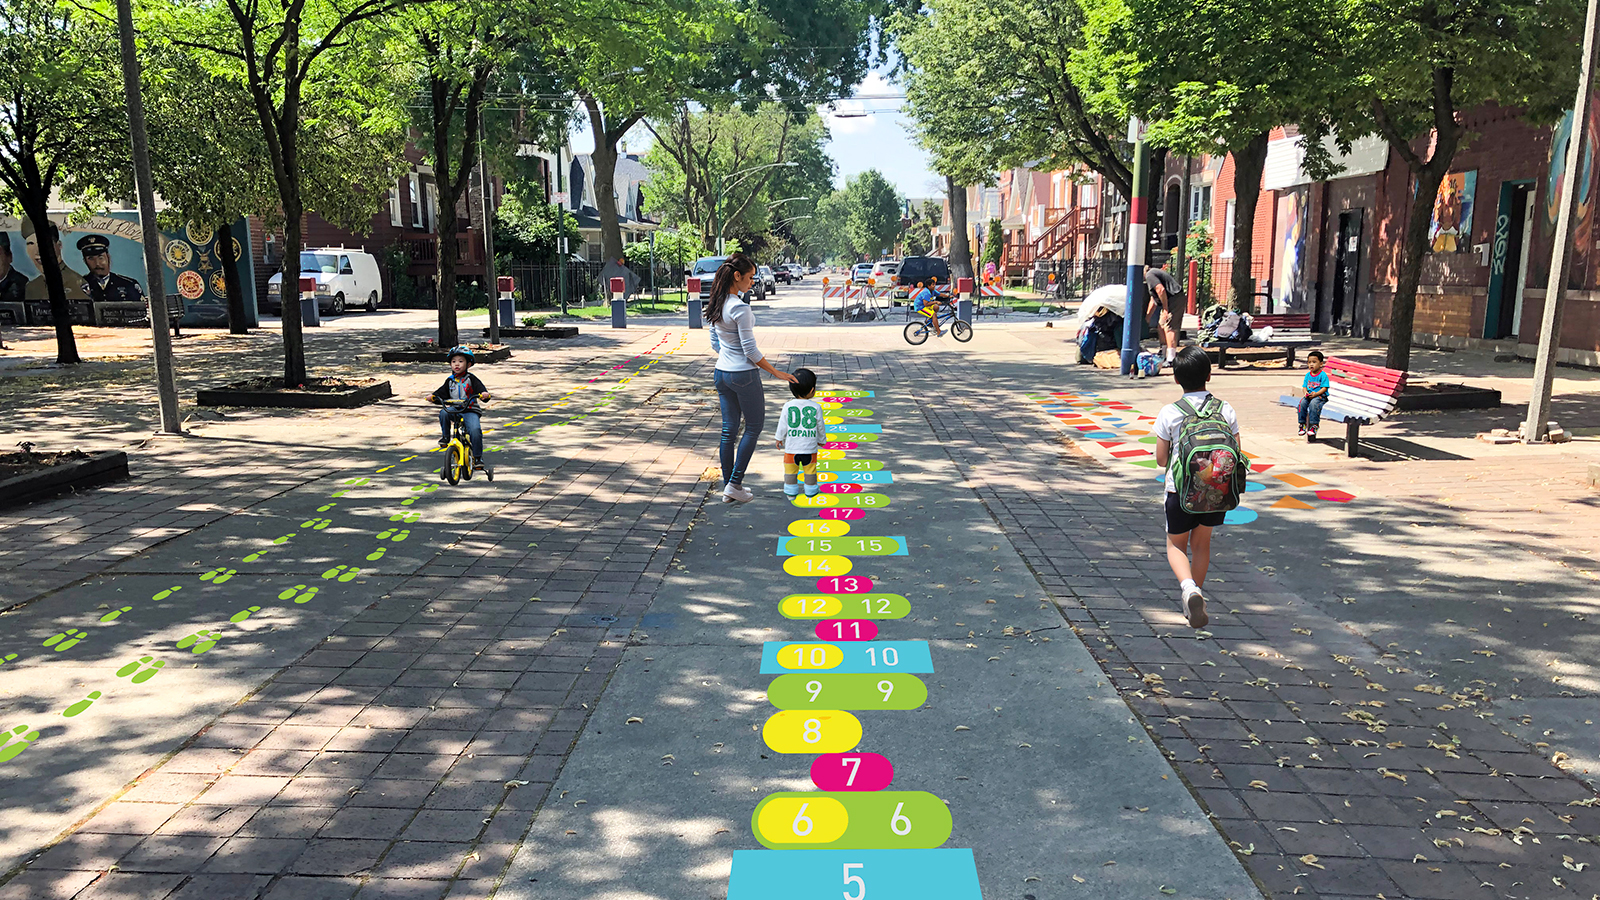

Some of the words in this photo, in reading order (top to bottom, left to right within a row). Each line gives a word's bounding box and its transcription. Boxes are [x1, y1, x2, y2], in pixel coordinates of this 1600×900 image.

[113, 221, 142, 240] Plaz
[787, 406, 817, 429] 08
[788, 429, 816, 437] COPAIN
[852, 461, 870, 469] 21
[818, 473, 828, 481] 0
[852, 473, 873, 481] 20
[830, 484, 851, 492] 19
[806, 496, 827, 505] 18
[853, 496, 876, 505] 18
[830, 509, 853, 518] 17
[807, 523, 830, 533] 16
[807, 540, 832, 551] 15
[857, 540, 882, 551] 15
[804, 559, 831, 572] 14
[830, 578, 858, 591] 13
[797, 599, 827, 614] 12
[861, 599, 892, 614] 12
[832, 622, 860, 638] 11
[793, 648, 826, 666] 10
[865, 648, 899, 666] 10
[805, 680, 823, 702] 9
[876, 680, 894, 702] 9
[802, 718, 822, 744] 8
[841, 758, 861, 786] 7
[792, 803, 813, 836] 6
[890, 802, 912, 836] 6
[843, 863, 866, 900] 5
